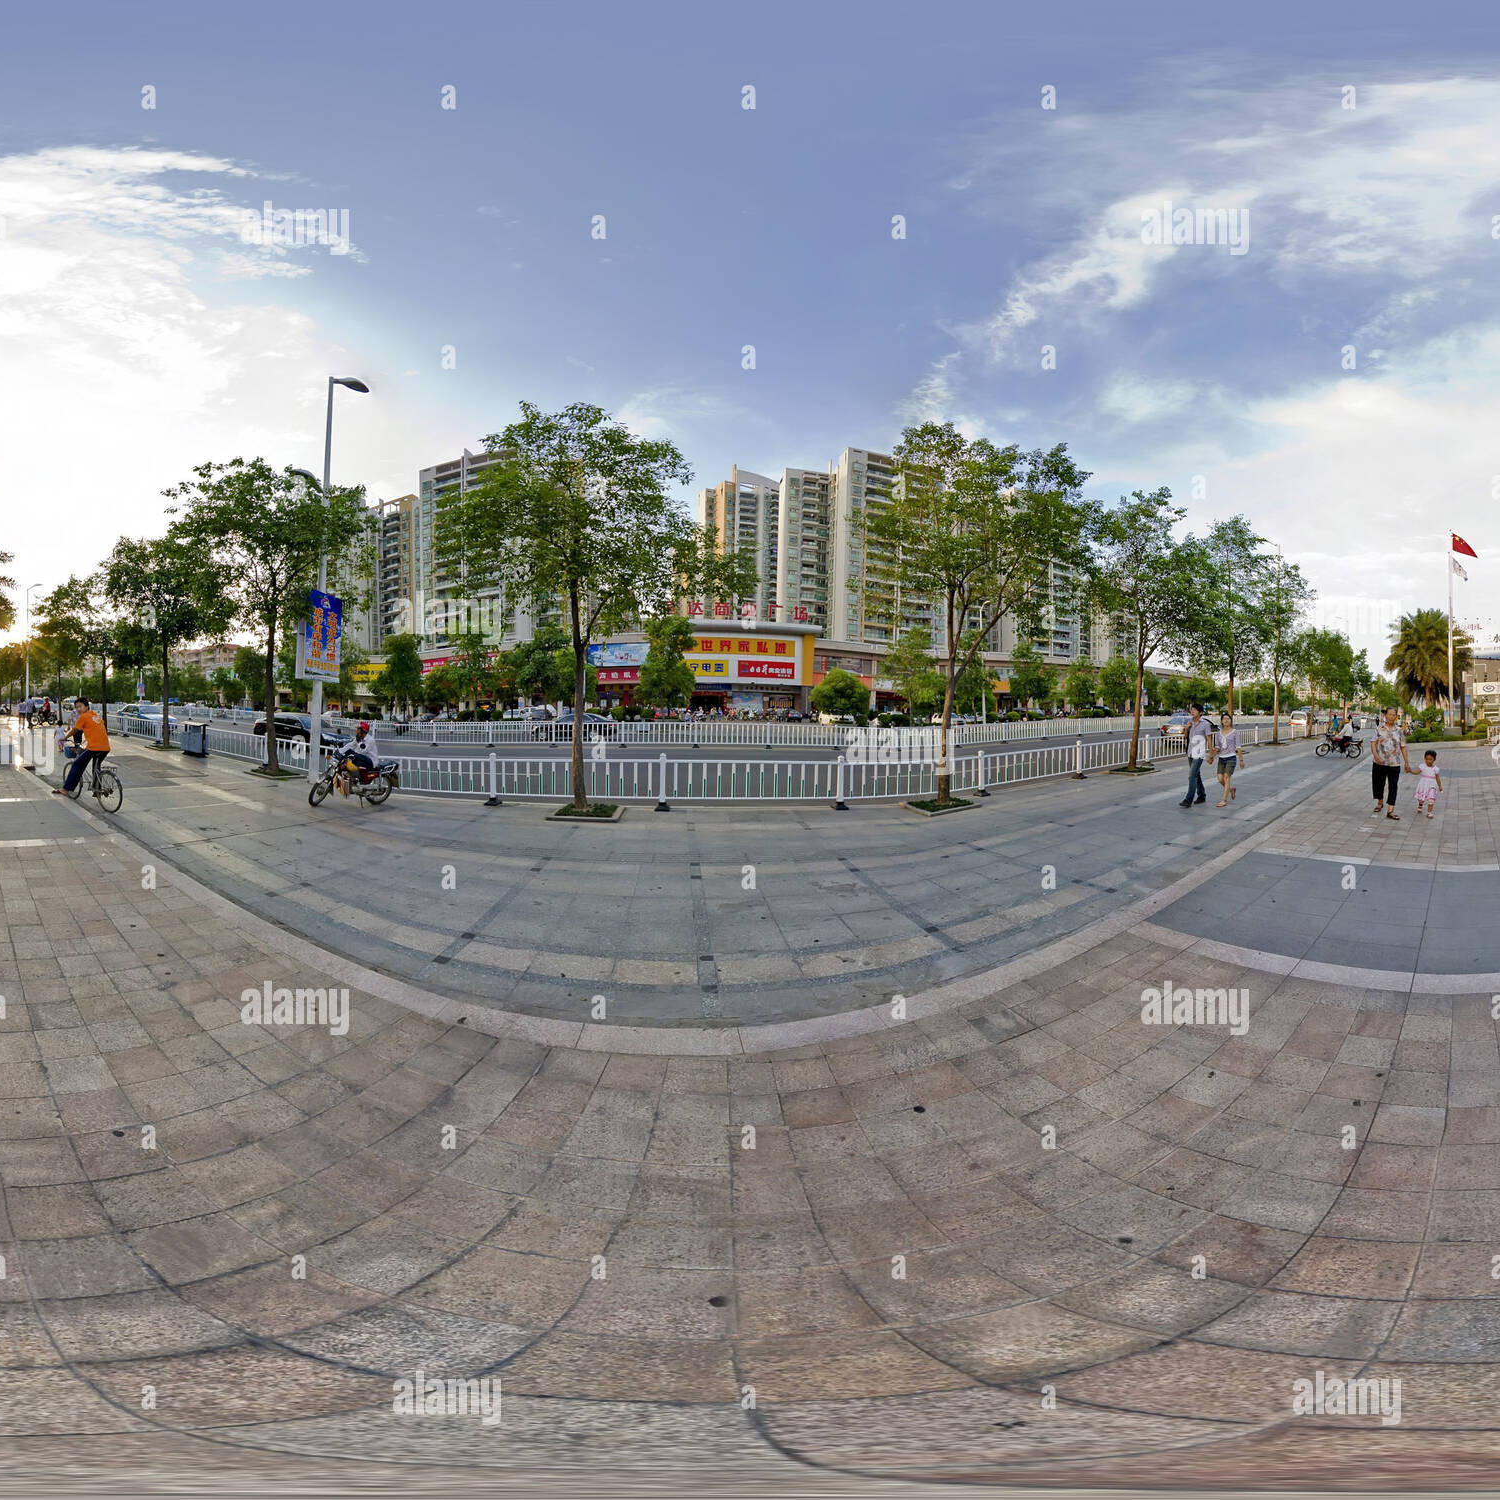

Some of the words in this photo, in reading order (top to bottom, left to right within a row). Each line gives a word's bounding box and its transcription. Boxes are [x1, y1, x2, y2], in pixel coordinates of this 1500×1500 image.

[686, 639, 788, 654] 世界家私城
